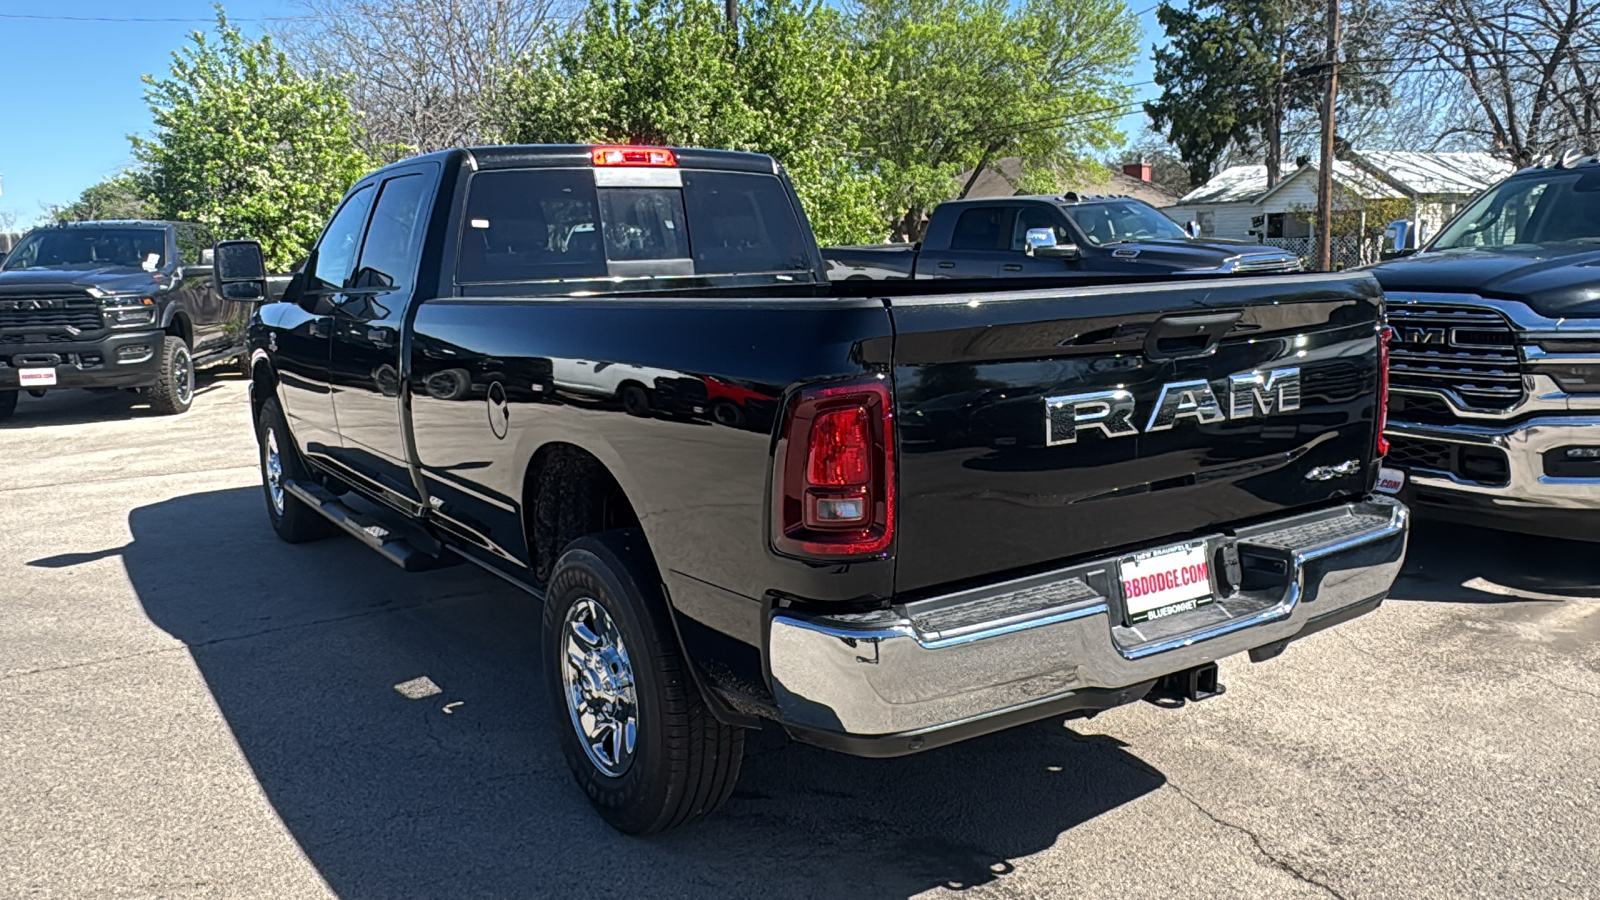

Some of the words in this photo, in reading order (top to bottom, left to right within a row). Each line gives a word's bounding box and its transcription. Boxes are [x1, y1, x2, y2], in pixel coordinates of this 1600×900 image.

[1045, 367, 1300, 447] RAM
[1124, 562, 1208, 599] BBDODGE.COM
[1147, 600, 1197, 620] BLUEBONNET
